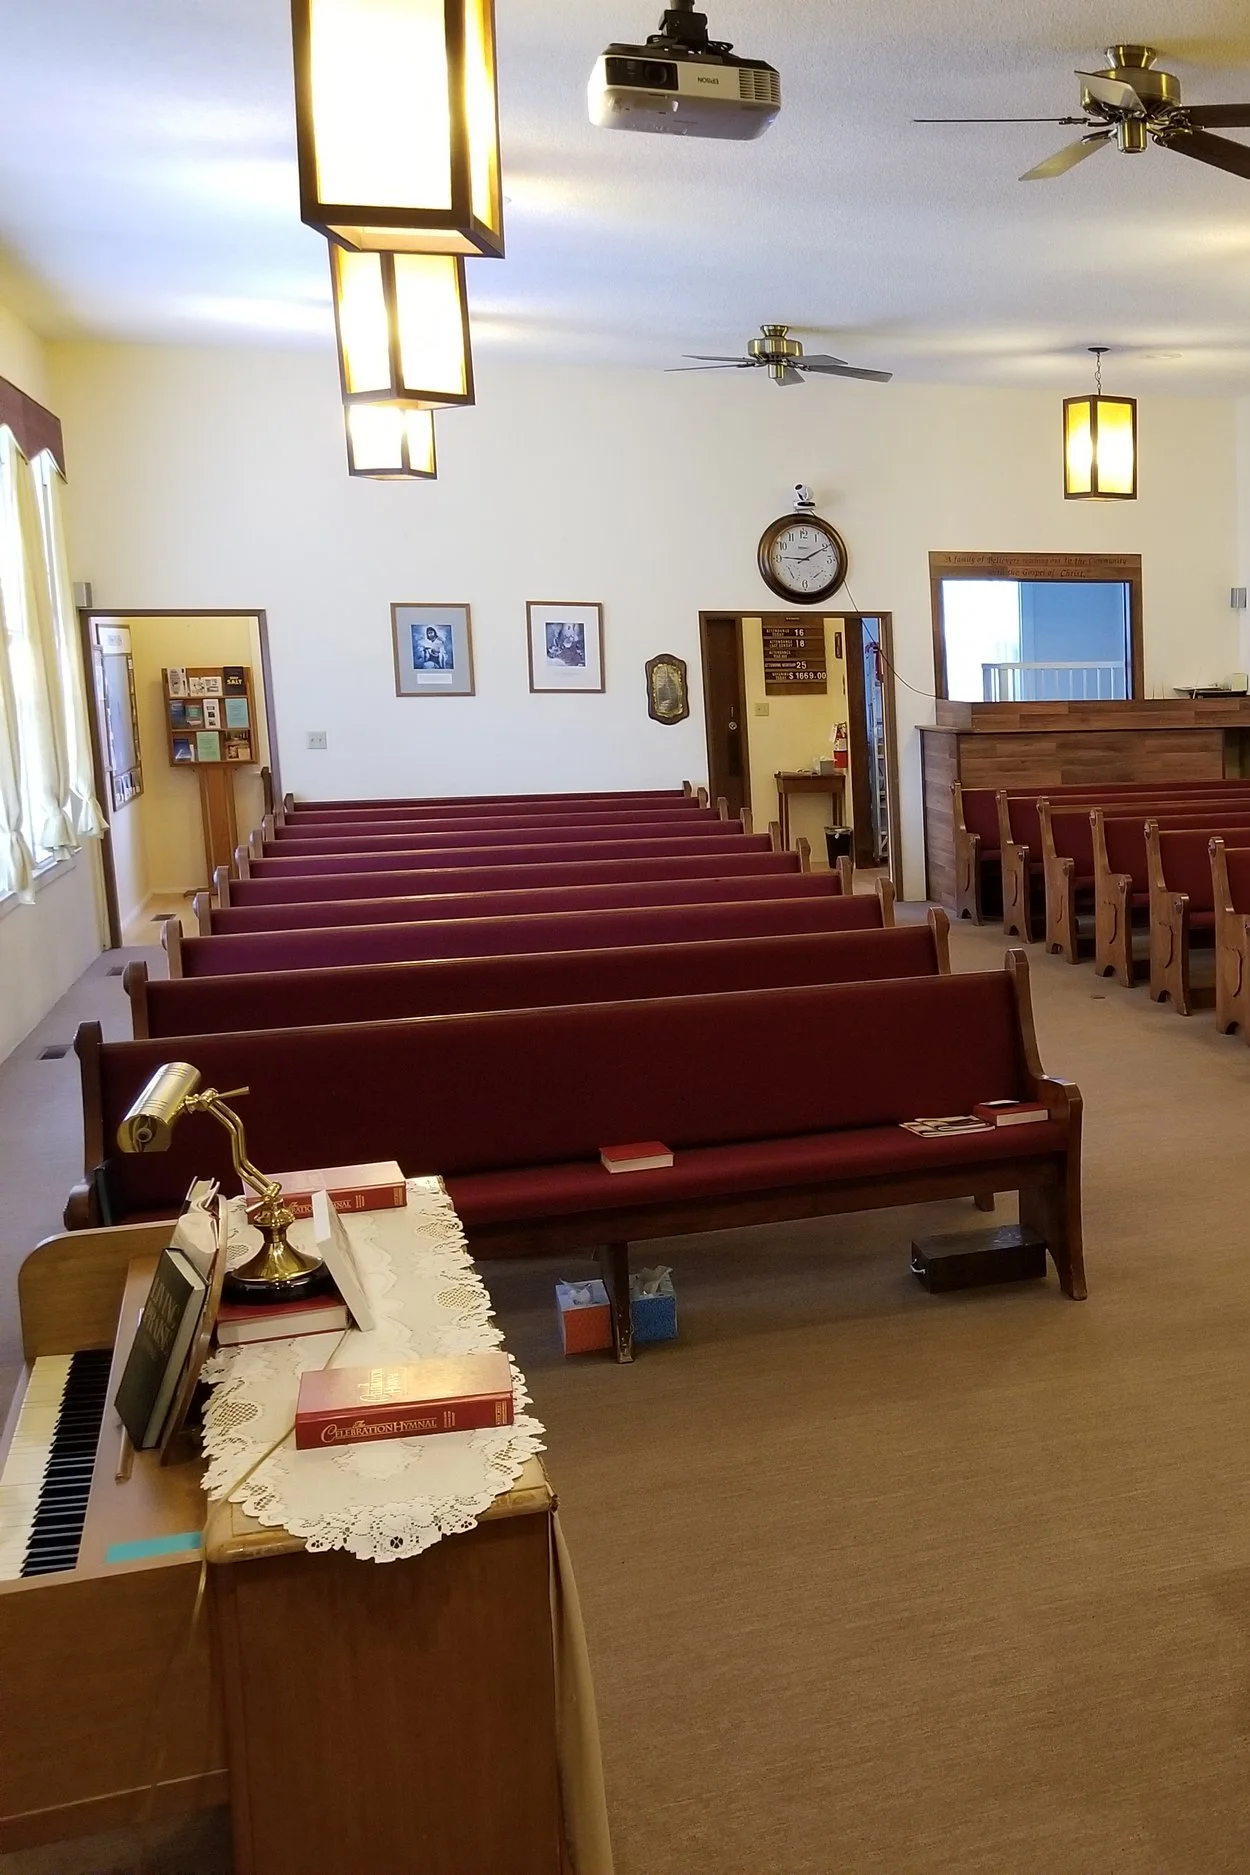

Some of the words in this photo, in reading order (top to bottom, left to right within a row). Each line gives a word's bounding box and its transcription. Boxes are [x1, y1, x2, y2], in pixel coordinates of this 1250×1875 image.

[794, 629, 805, 637] 16
[796, 639, 805, 648] 18
[796, 660, 807, 669] 25
[321, 1422, 393, 1443] CELEBRATION
[393, 1420, 437, 1432] HYMNAL
